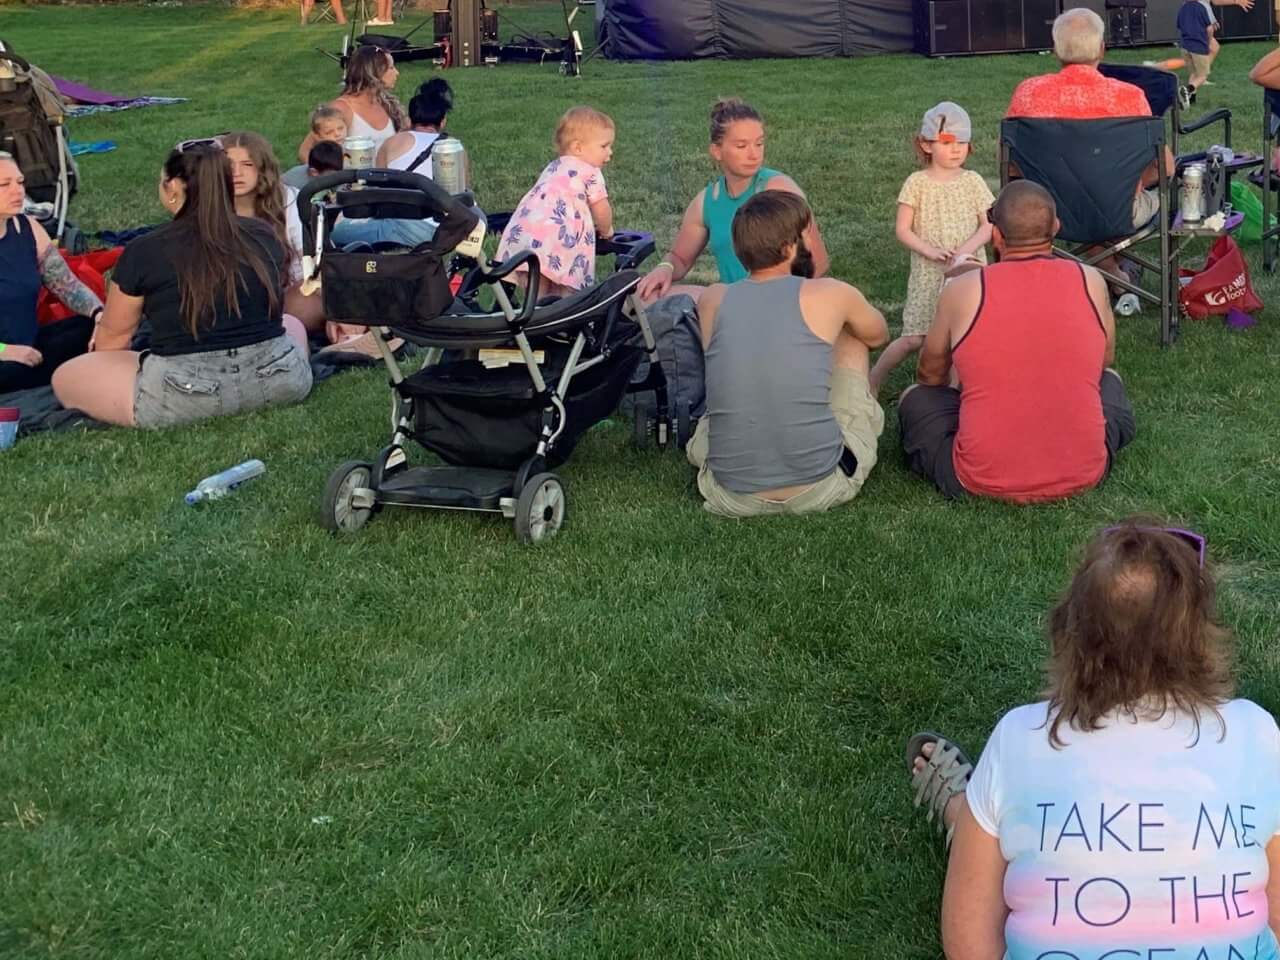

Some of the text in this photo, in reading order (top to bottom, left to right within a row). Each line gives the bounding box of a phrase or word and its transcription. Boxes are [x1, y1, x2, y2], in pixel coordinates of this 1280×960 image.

[1036, 801, 1262, 852] TAKE ME
[1045, 871, 1255, 927] TO THE
